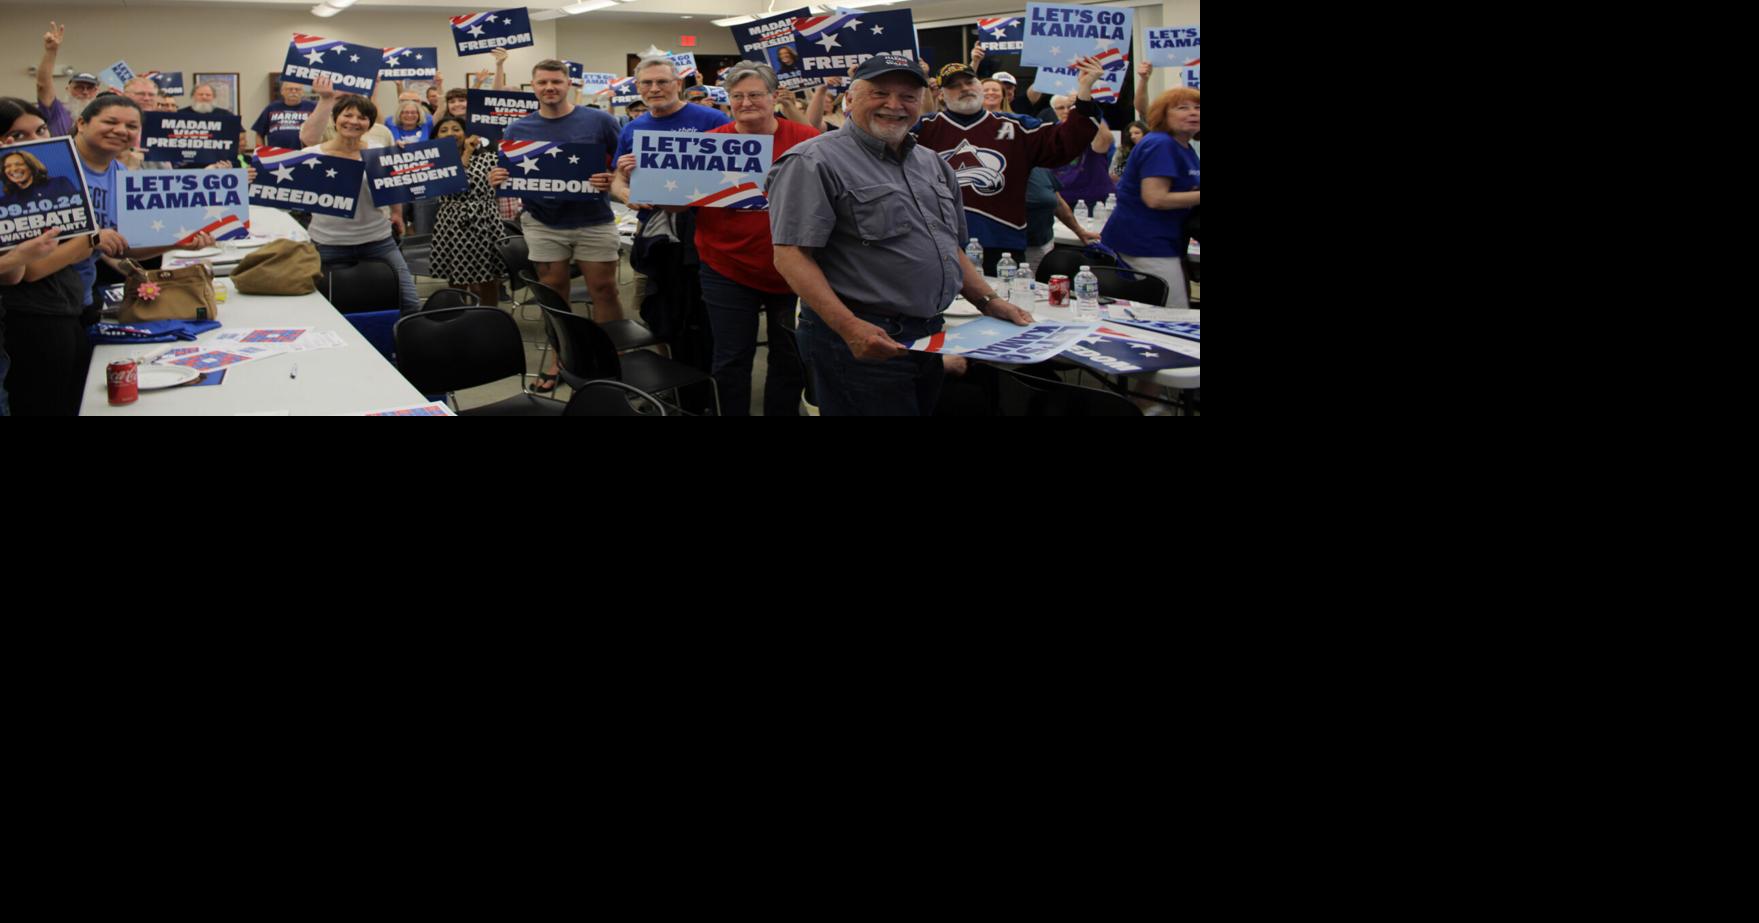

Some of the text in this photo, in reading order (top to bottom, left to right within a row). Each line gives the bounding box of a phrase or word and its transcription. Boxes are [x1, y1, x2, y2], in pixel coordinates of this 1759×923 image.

[1032, 7, 1125, 26] LET'S GO
[1031, 22, 1124, 40] KAMALA
[1149, 28, 1197, 39] LET'S
[458, 33, 531, 52] FREEDOM
[981, 41, 1024, 51] FREED
[1150, 38, 1200, 49] KAMA
[285, 64, 374, 90] FREEDOM
[378, 68, 437, 77] FREEDOM
[484, 97, 539, 110] MADAM
[161, 119, 222, 131] MADAM
[471, 114, 515, 126] PRESI
[995, 122, 1015, 140] A
[146, 137, 233, 150] PRESIDENT
[641, 136, 762, 155] LET'S GO
[379, 147, 440, 167] MADAM
[640, 153, 763, 173] KAMALA
[126, 174, 239, 192] LET'S GO
[374, 165, 459, 190] PRESIDENT
[500, 177, 600, 194] FREEDOM
[126, 190, 241, 210] KAMALA
[248, 184, 354, 211] FREEDOM
[0, 207, 87, 235] DEBATE
[0, 220, 87, 243] WATCH ARTY
